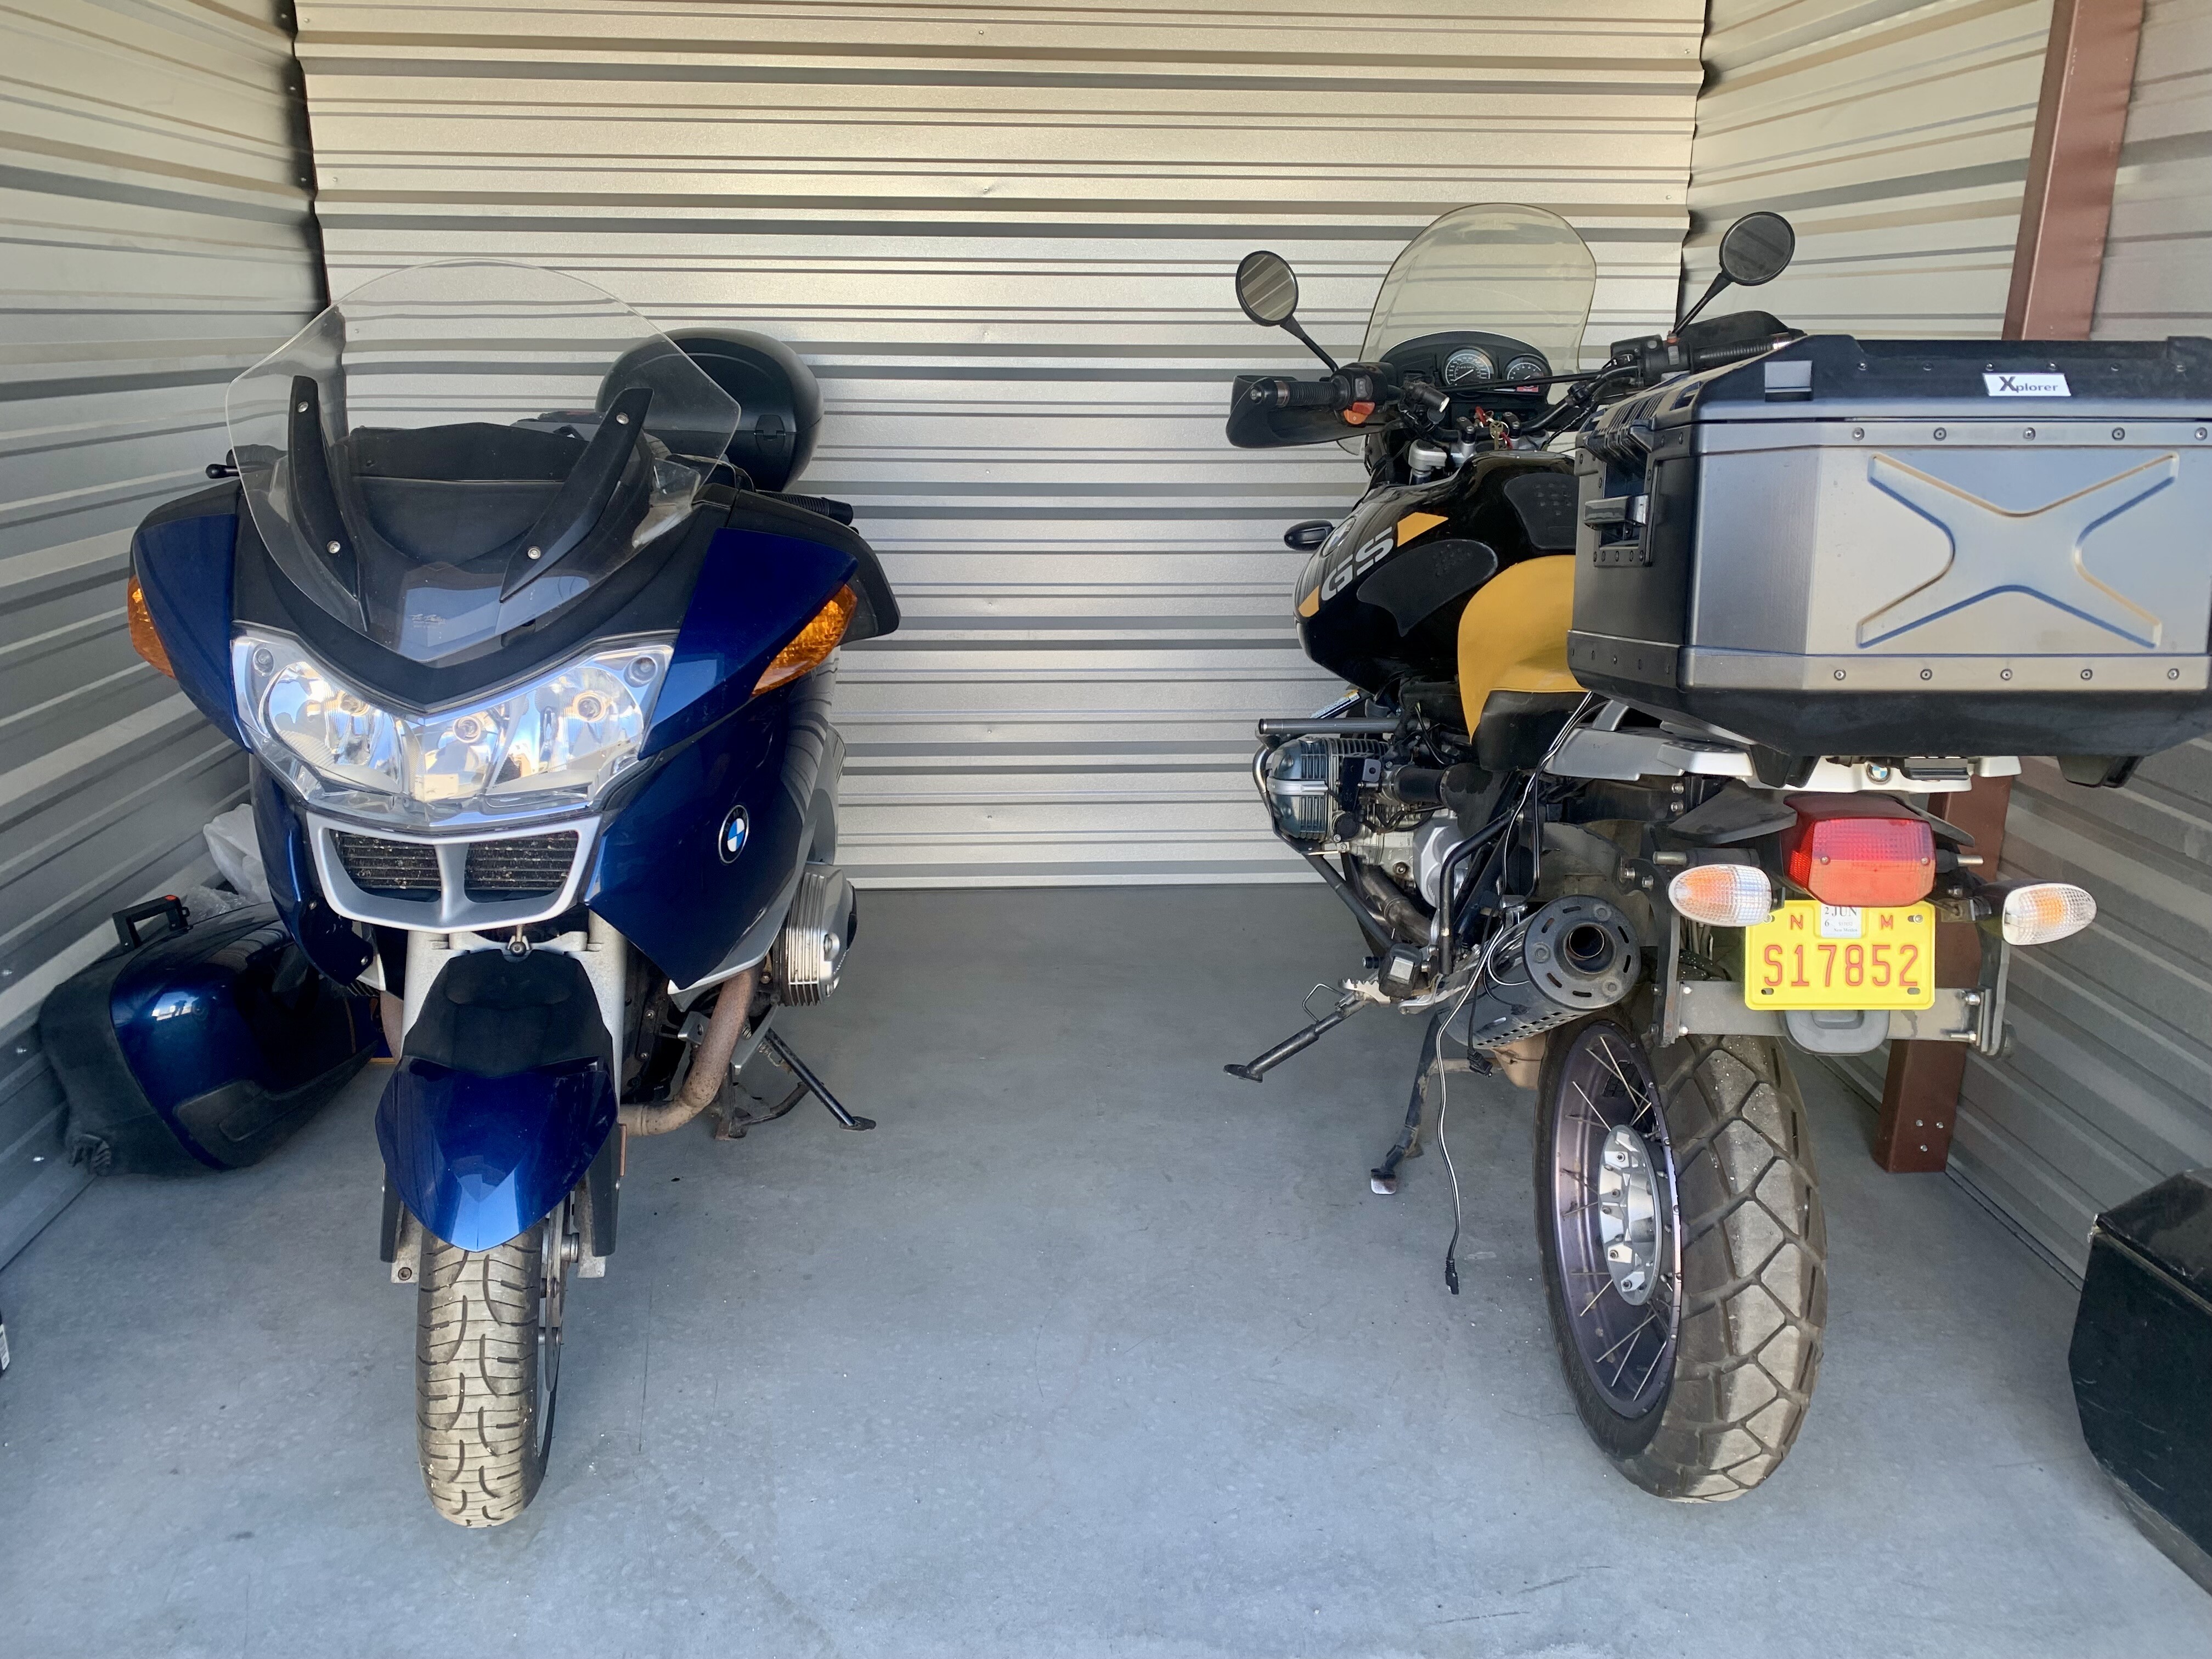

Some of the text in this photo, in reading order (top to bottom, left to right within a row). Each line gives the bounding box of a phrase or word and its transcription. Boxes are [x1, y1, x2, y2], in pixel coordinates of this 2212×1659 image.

[1999, 376, 2058, 393] Xplorer
[1321, 527, 1394, 601] GS
[1832, 906, 1857, 916] JUN
[1790, 914, 1894, 930] N M
[1764, 944, 1919, 987] S17852
